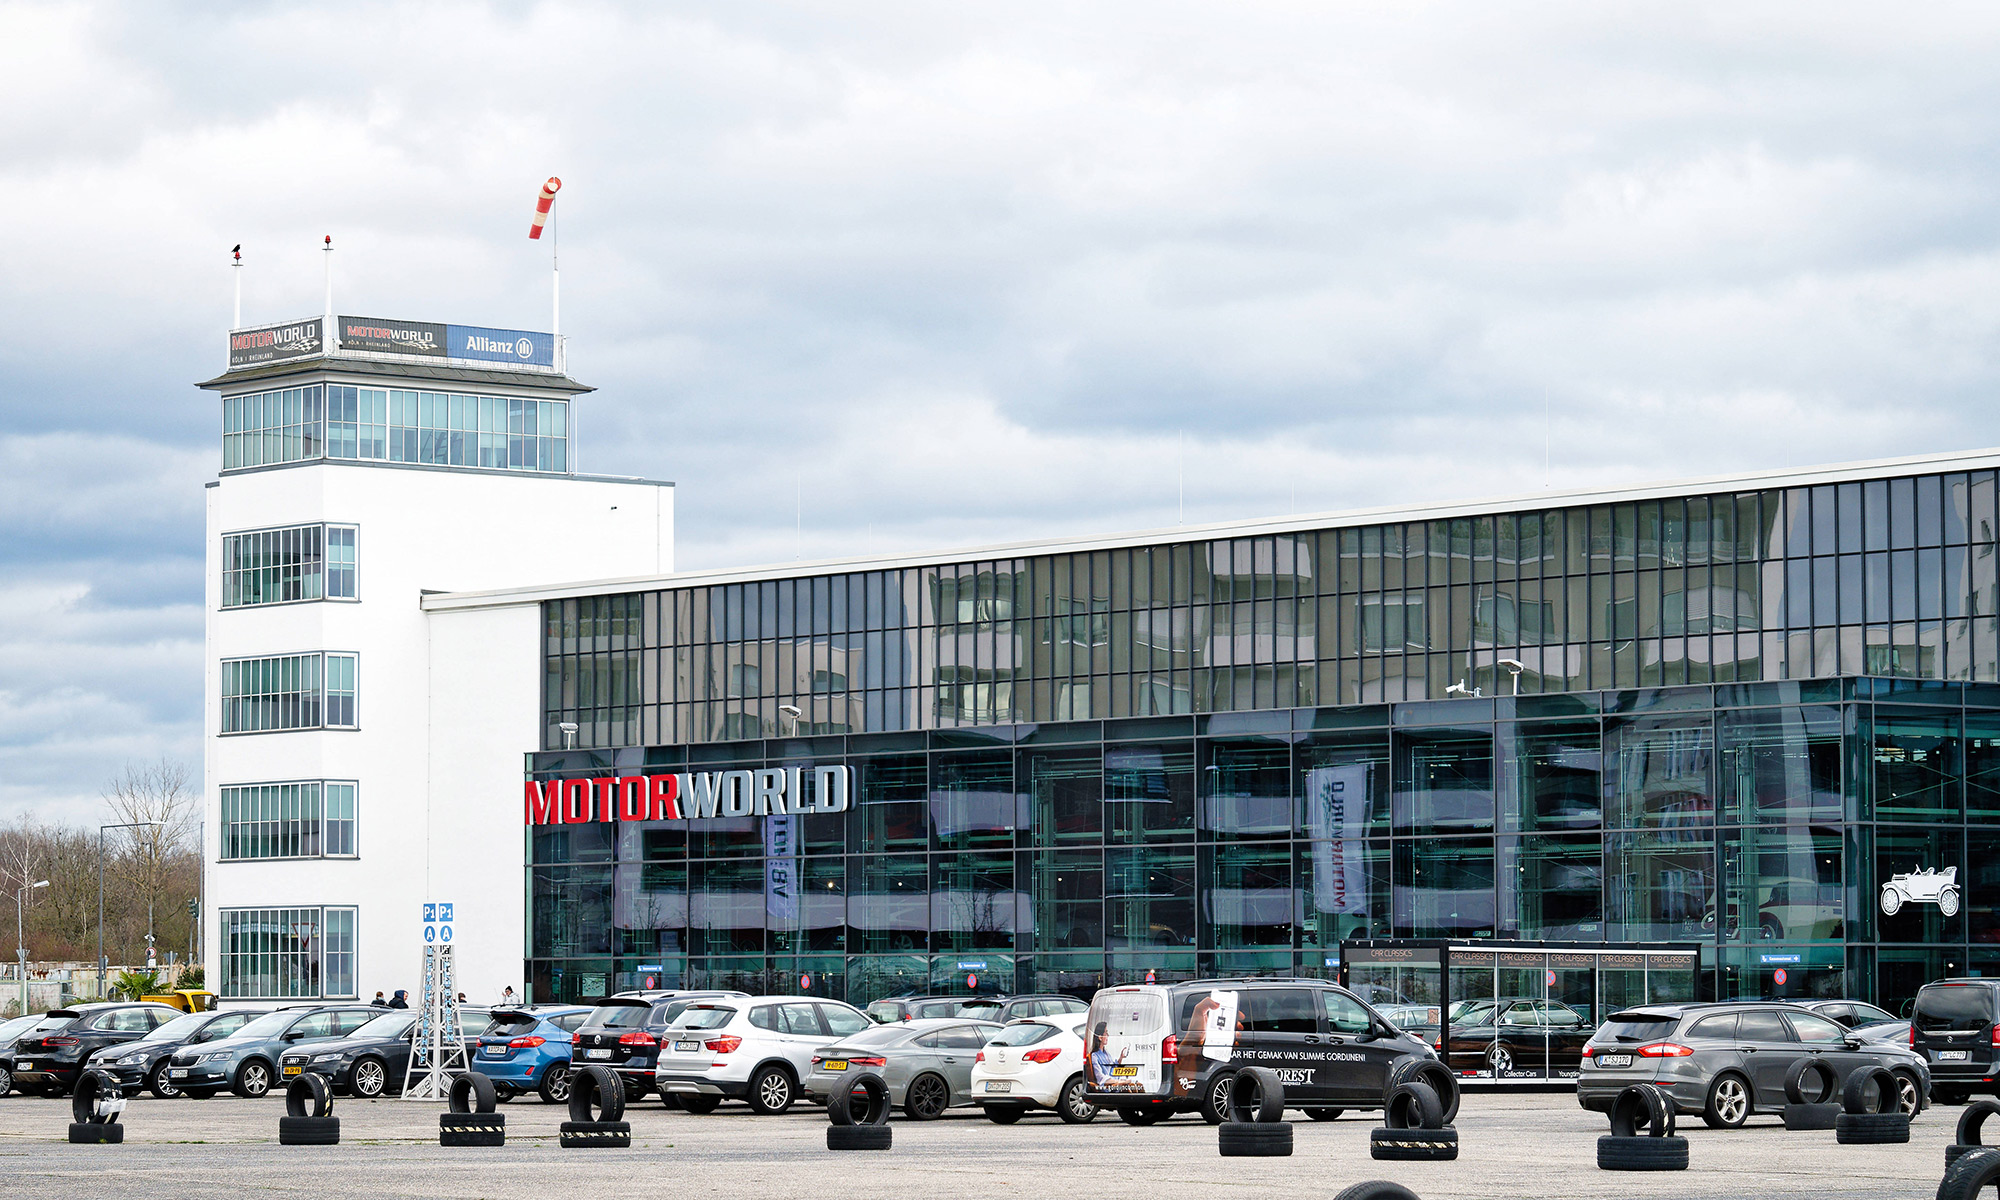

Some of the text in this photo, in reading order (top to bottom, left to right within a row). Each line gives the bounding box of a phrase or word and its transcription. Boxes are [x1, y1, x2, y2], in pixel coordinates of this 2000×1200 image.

[232, 324, 315, 350] MOTORWORLD
[347, 325, 433, 342] MOTORWORLD
[466, 335, 514, 354] Allianz
[525, 765, 849, 825] MOTORWORLD
[424, 905, 435, 919] P1
[440, 905, 452, 919] P1
[426, 927, 434, 940] A
[442, 927, 451, 940] A
[1370, 949, 1413, 958] CAR CLASSICS
[1450, 952, 1494, 960] CAR CLASSICS
[1500, 953, 1543, 961] CAR CLASSICS
[1564, 954, 1594, 962] CLASSICS
[1601, 954, 1643, 963] CAR CLASSICS
[1650, 955, 1692, 963] CAR CLASSICS
[1135, 1043, 1157, 1051] FOREST
[1243, 1050, 1256, 1059] HET
[1257, 1050, 1282, 1059] GEMAK
[1283, 1051, 1298, 1060] VAN
[1300, 1051, 1325, 1060] SLIMME
